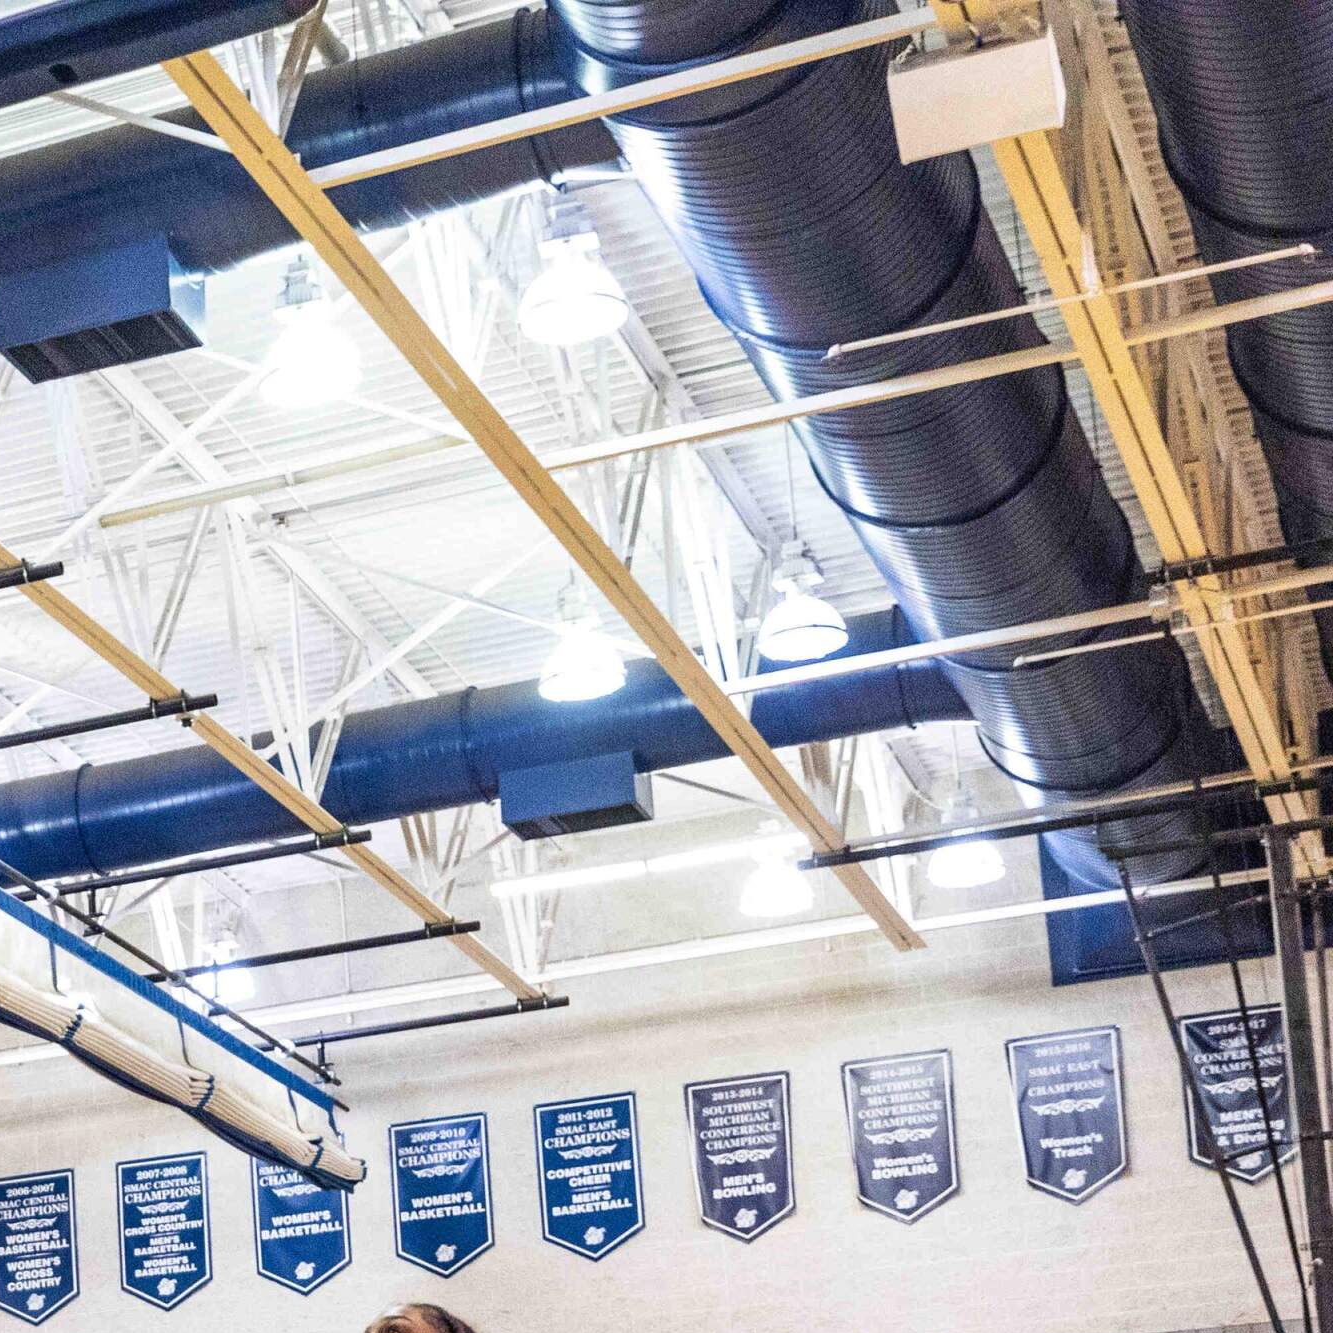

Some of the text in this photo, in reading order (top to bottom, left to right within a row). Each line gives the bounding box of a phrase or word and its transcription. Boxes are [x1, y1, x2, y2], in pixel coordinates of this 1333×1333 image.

[702, 1099, 774, 1117] SOUTHWEST
[544, 1127, 630, 1150] CHAMPIONS
[700, 1121, 781, 1140] CONFERENCE
[705, 1133, 777, 1151] CHAMPIONS
[398, 1147, 482, 1168] CHAMPIONS
[546, 1159, 632, 1180] COMPETITIVE
[871, 1163, 939, 1180] BOWLING
[124, 1176, 201, 1194] SMAC CENTRAL
[568, 1173, 612, 1188] CHEER
[722, 1172, 765, 1188] MEN'S
[124, 1185, 202, 1204] CHAMPIONS
[571, 1189, 612, 1204] MEN'S
[713, 1181, 777, 1200] BOWLING
[411, 1191, 473, 1209] WOMEN'S
[552, 1198, 633, 1217] BASKETBALL
[140, 1213, 187, 1226] WOMEN'S
[271, 1210, 331, 1227] WOMEN'S
[400, 1202, 485, 1222] BASKETBALL
[5, 1229, 60, 1245] WOMEN'S
[124, 1219, 203, 1237] CROSS COUNTRY
[260, 1220, 343, 1241] BASKETBALL
[134, 1242, 197, 1256] BASKETBALL
[6, 1256, 61, 1272] WOMEN'S
[134, 1263, 198, 1278] BASKETBALL
[142, 1255, 189, 1269] WOMEN'S
[14, 1267, 54, 1281] CROSS
[6, 1276, 62, 1292] COUNTRY
